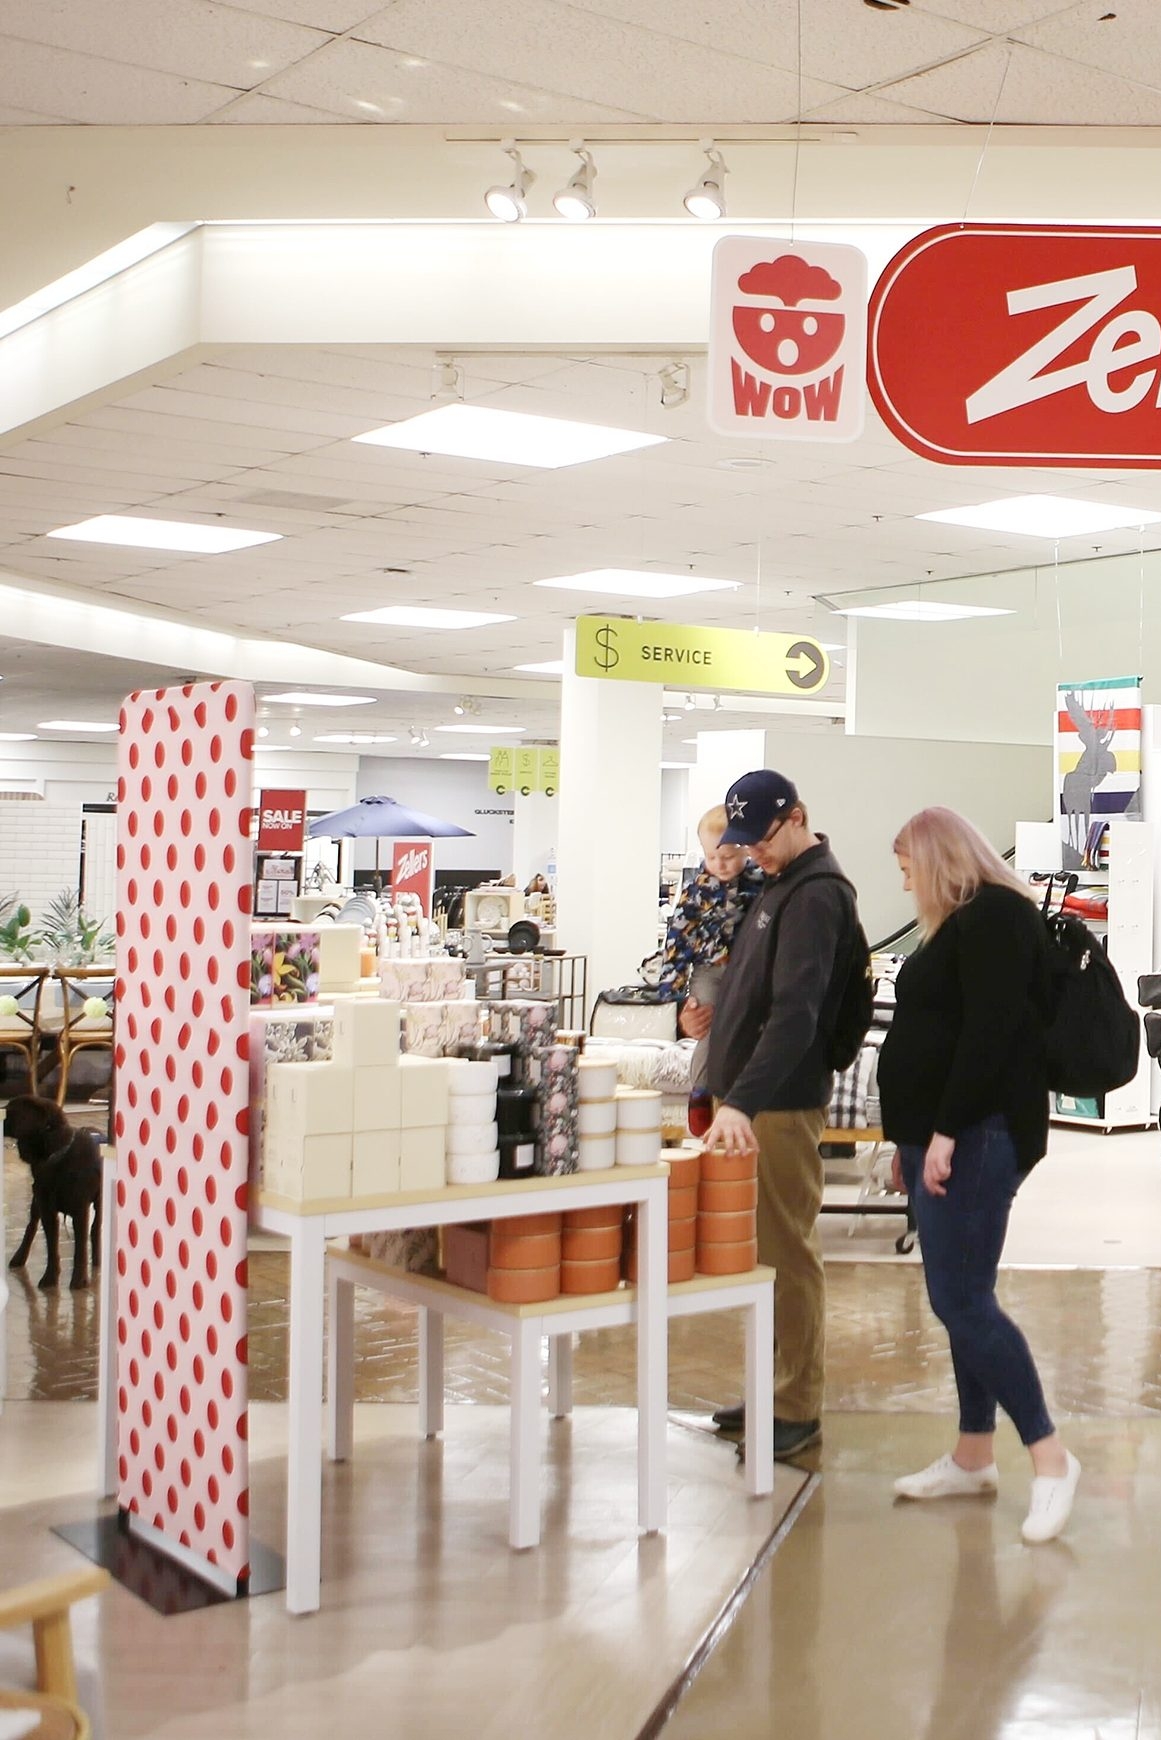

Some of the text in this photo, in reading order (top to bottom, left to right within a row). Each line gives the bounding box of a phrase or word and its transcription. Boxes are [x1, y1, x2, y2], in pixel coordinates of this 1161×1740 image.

[731, 360, 845, 422] WOW
[641, 645, 712, 665] SERVICE
[262, 810, 302, 823] SALE
[395, 849, 428, 885] Zellers
